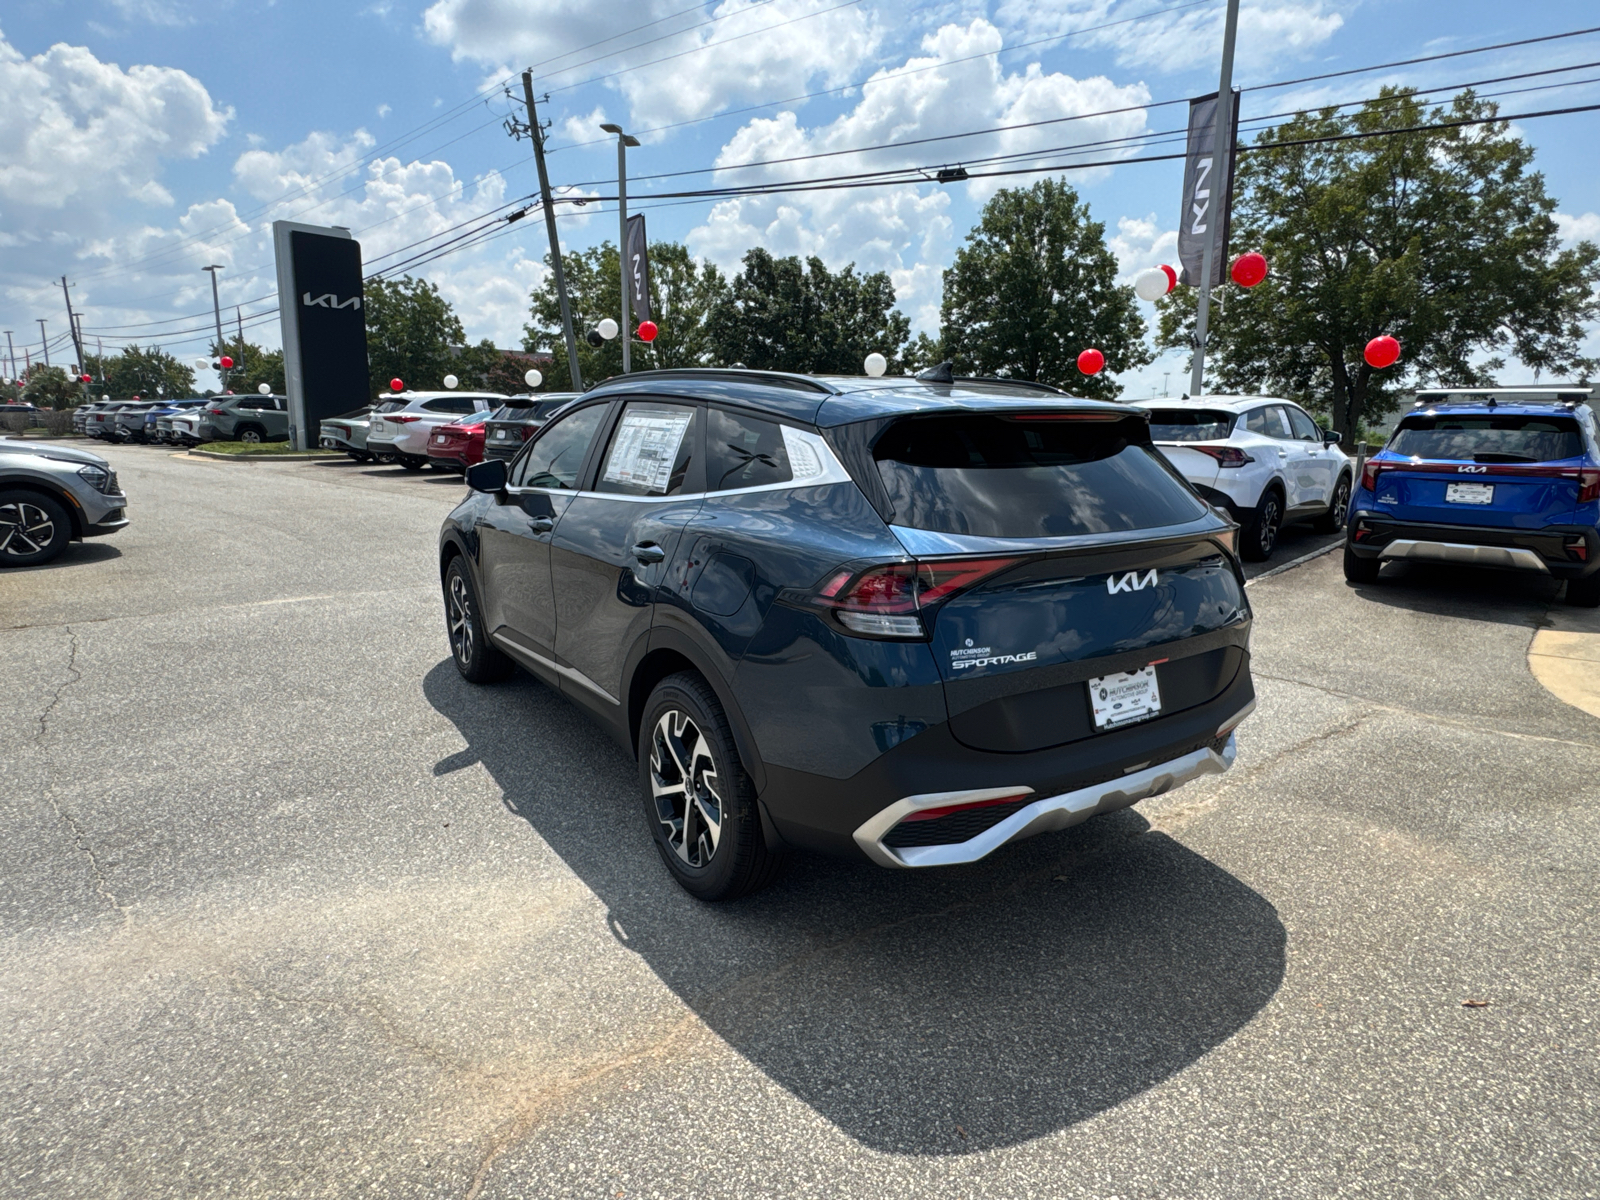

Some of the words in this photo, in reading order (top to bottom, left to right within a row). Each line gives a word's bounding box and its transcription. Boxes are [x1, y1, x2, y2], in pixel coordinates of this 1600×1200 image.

[1191, 157, 1213, 235] KIA
[303, 291, 361, 311] KIA
[1458, 465, 1487, 473] KIA
[1106, 568, 1159, 595] KIA
[950, 647, 991, 656] HUTCHINSON
[952, 651, 1037, 669] SPORTAGE
[1109, 680, 1149, 697] HUTCHINSON
